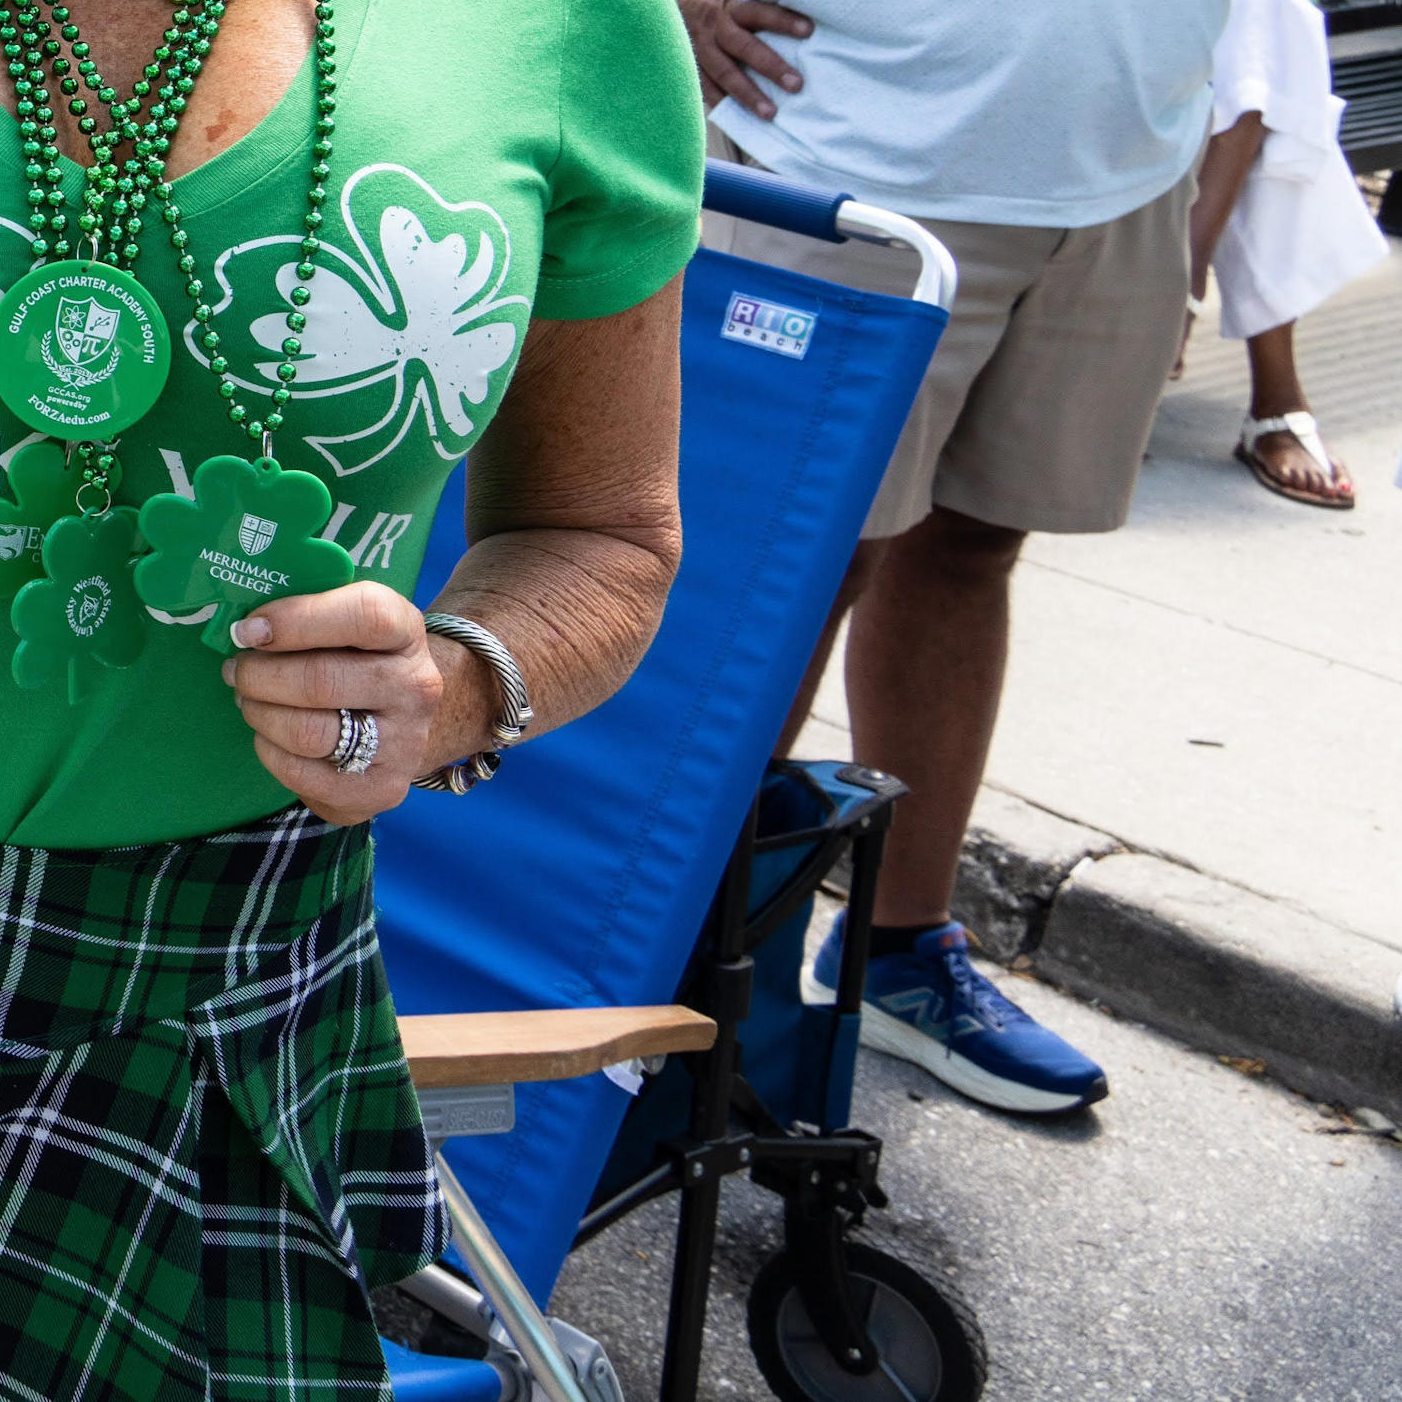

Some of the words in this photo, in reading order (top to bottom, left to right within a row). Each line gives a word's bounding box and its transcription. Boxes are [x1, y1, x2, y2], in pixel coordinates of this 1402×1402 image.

[8, 303, 29, 334] GULF
[26, 280, 57, 306] COAST
[58, 276, 107, 292] CHARTER
[106, 284, 147, 325] ACADEMY
[140, 323, 156, 364] SOUTH
[733, 300, 808, 337] RIO
[727, 323, 803, 350] beach
[27, 394, 111, 426] FORZAedu.com
[48, 386, 92, 404] GCCAS.org
[199, 548, 291, 587] MERRIMACK
[209, 565, 274, 596] COLLEGE
[72, 575, 112, 597] Westfield
[65, 596, 94, 637] University
[94, 598, 112, 628] State
